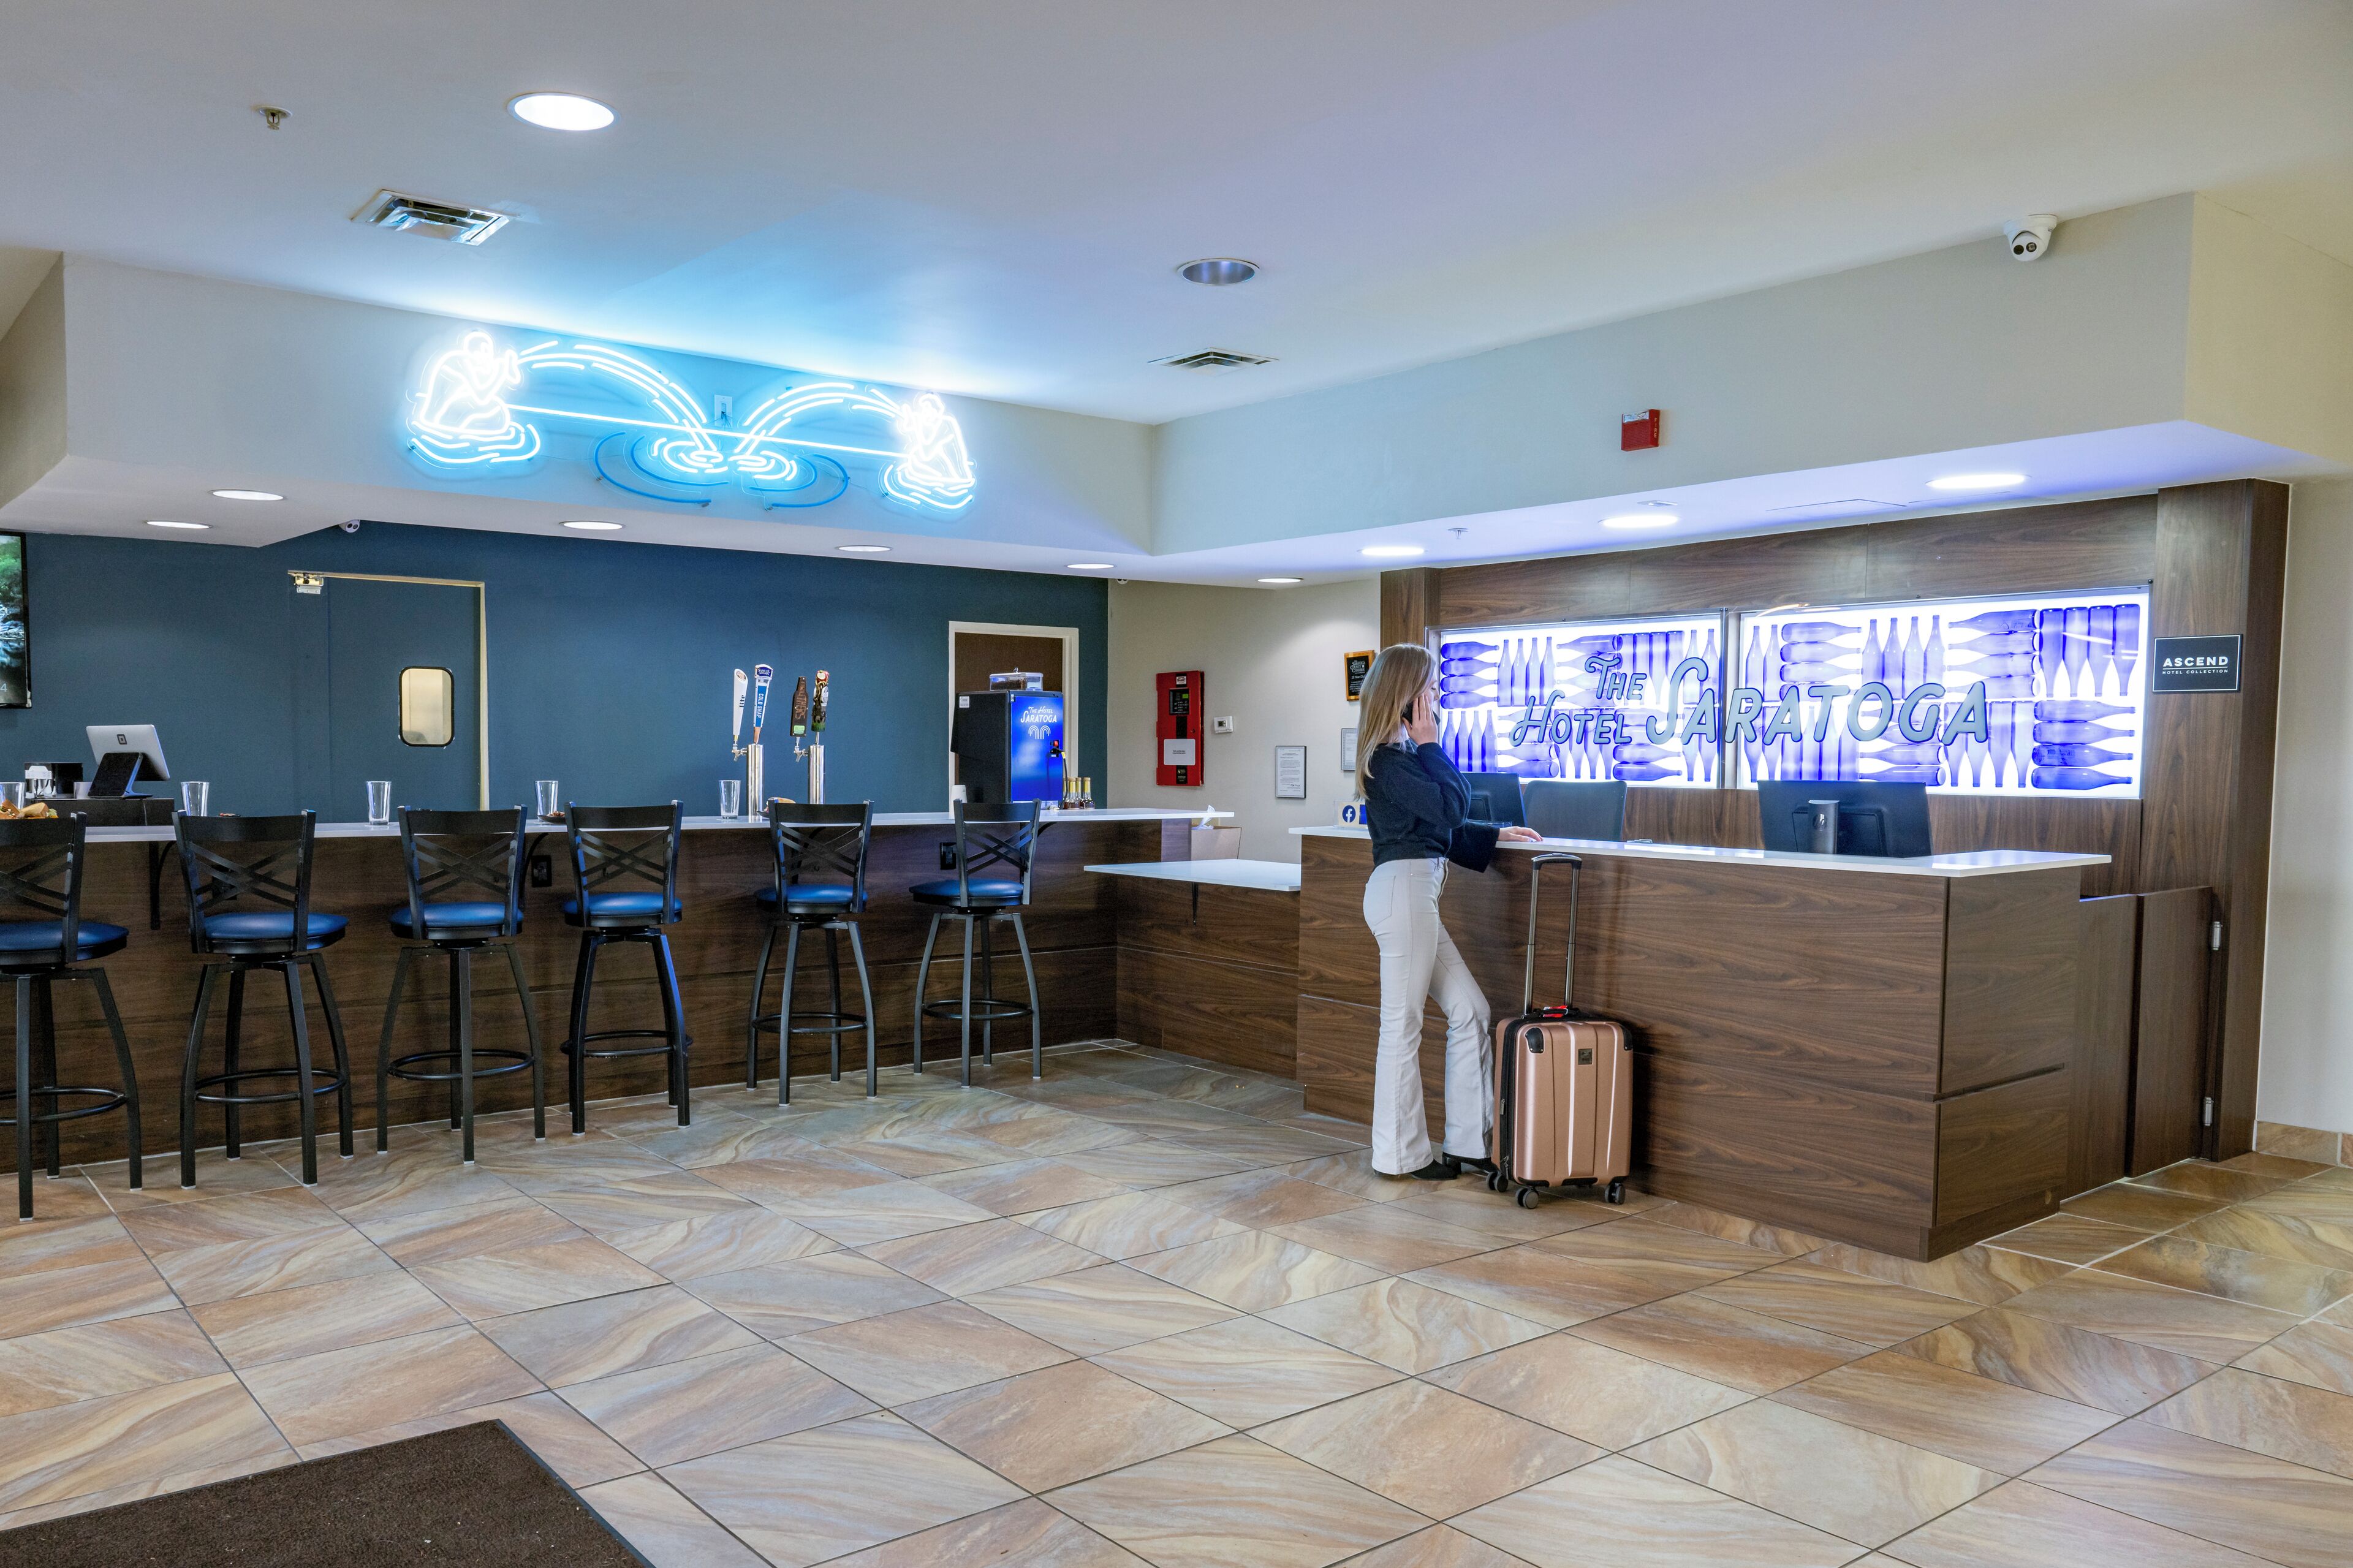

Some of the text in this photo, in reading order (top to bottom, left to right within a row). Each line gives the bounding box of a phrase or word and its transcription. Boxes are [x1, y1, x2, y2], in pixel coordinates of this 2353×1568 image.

[2163, 656, 2228, 667] ASCEND
[1585, 656, 1647, 700] THE
[1509, 657, 1989, 747] HOTEL SARATOGA
[1020, 710, 1057, 723] SARATOGA
